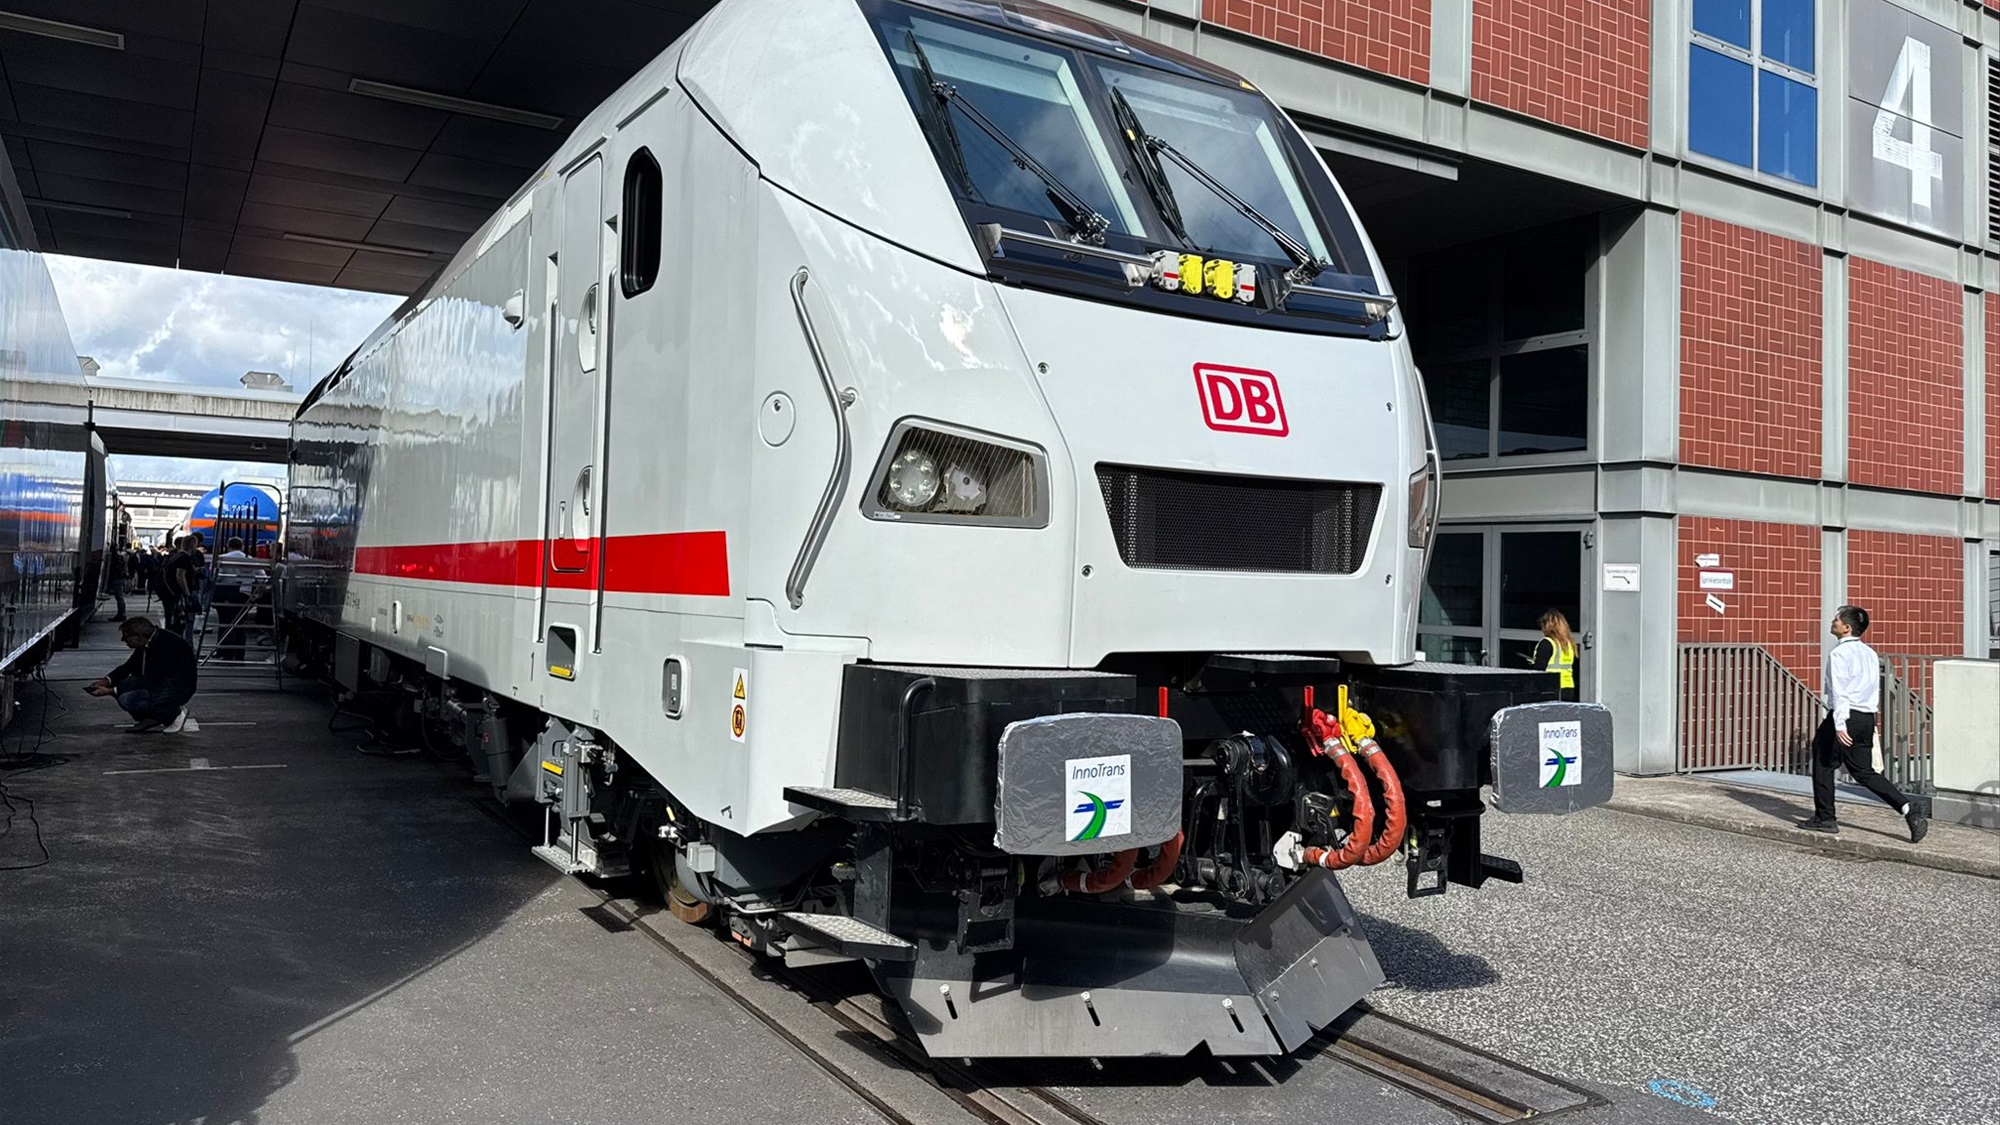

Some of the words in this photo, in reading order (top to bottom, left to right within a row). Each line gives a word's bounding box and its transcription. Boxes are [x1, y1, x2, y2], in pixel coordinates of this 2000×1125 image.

[1873, 36, 1942, 208] 4
[1206, 374, 1276, 424] DB
[1543, 727, 1578, 739] InnoTrans
[1072, 763, 1125, 780] InnoTrans
